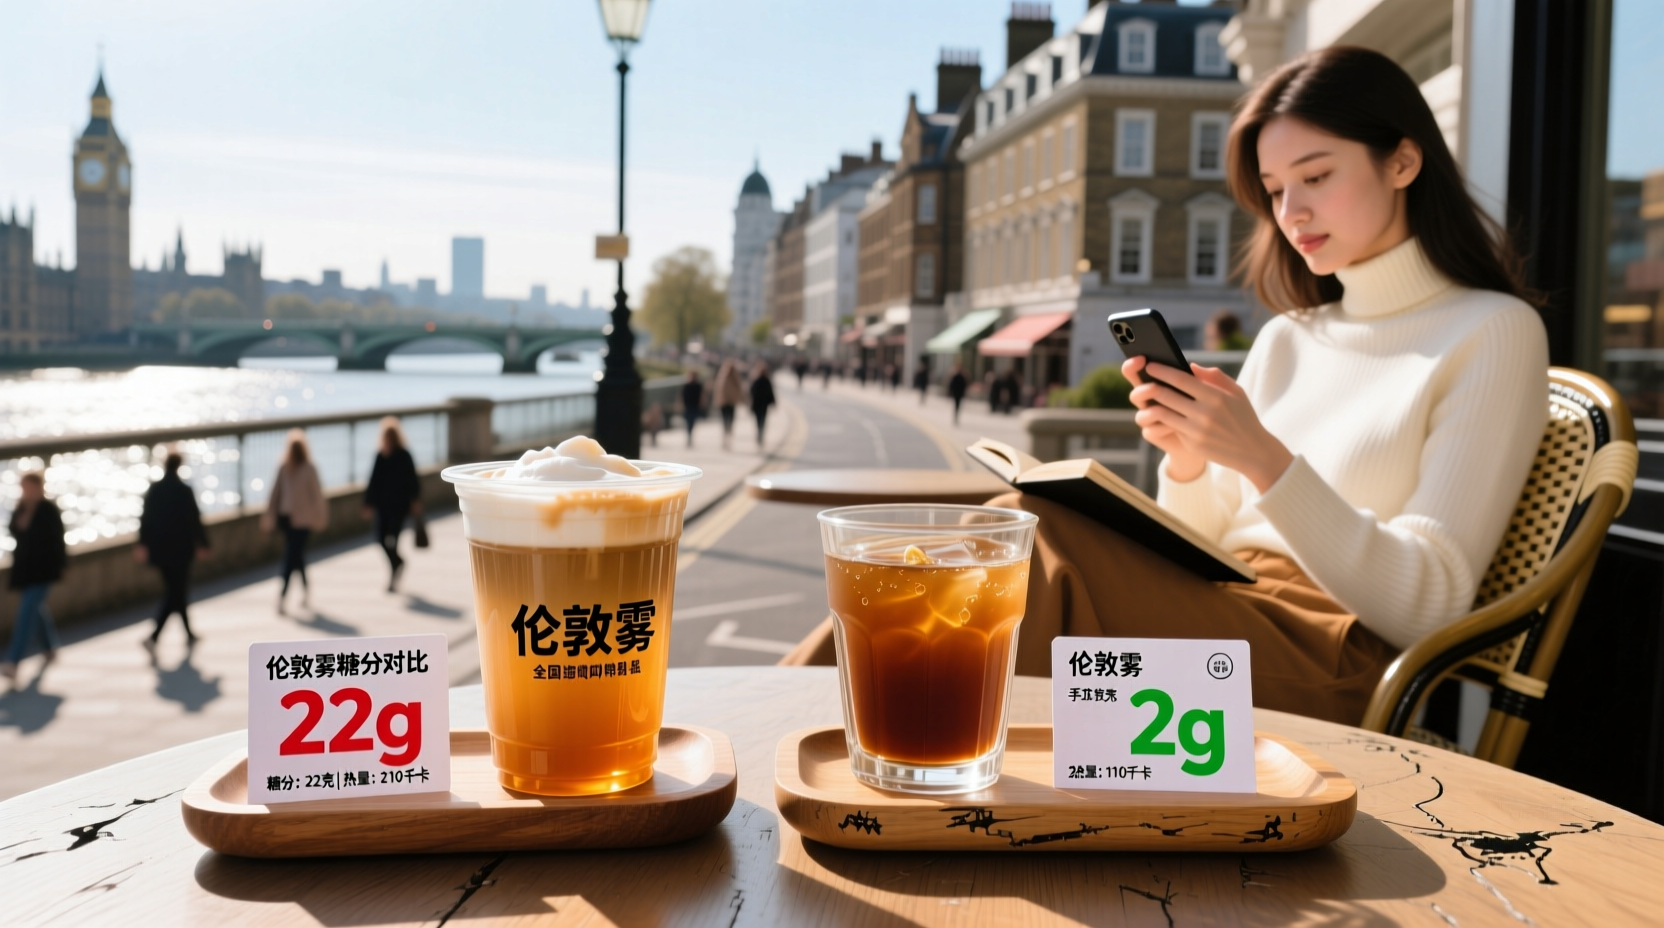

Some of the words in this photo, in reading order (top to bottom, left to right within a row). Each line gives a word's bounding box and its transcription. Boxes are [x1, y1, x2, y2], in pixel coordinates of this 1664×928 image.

[512, 600, 656, 656] 伦敦雾
[266, 649, 429, 680] 伦敦雾糖分对比
[1069, 650, 1143, 677] 伦敦雾
[280, 687, 422, 767] 22g
[1130, 689, 1226, 776] 2g
